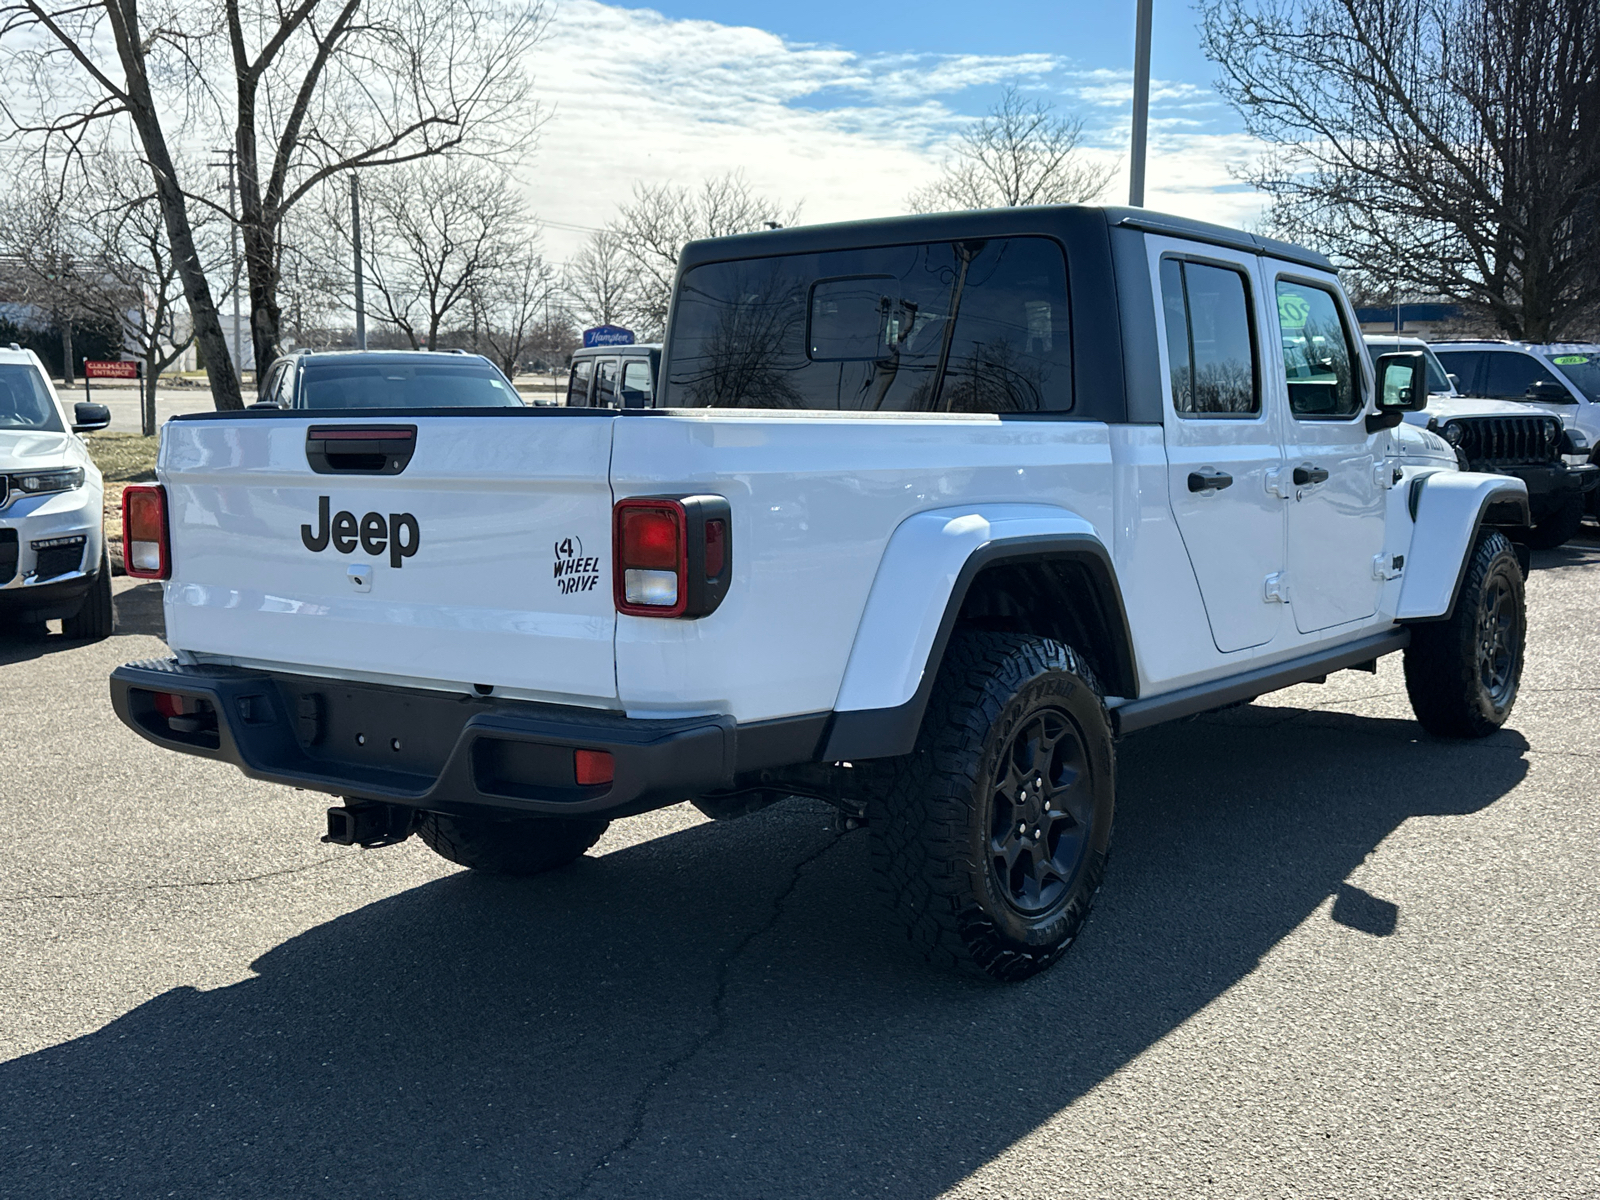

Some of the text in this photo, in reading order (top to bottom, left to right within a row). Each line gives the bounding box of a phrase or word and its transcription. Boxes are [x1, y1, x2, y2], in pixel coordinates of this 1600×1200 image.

[589, 331, 630, 344] Hampton
[301, 495, 420, 568] Jeep
[554, 535, 582, 560] (4)
[554, 557, 599, 578] WHEEL
[557, 575, 599, 595] DRIVE
